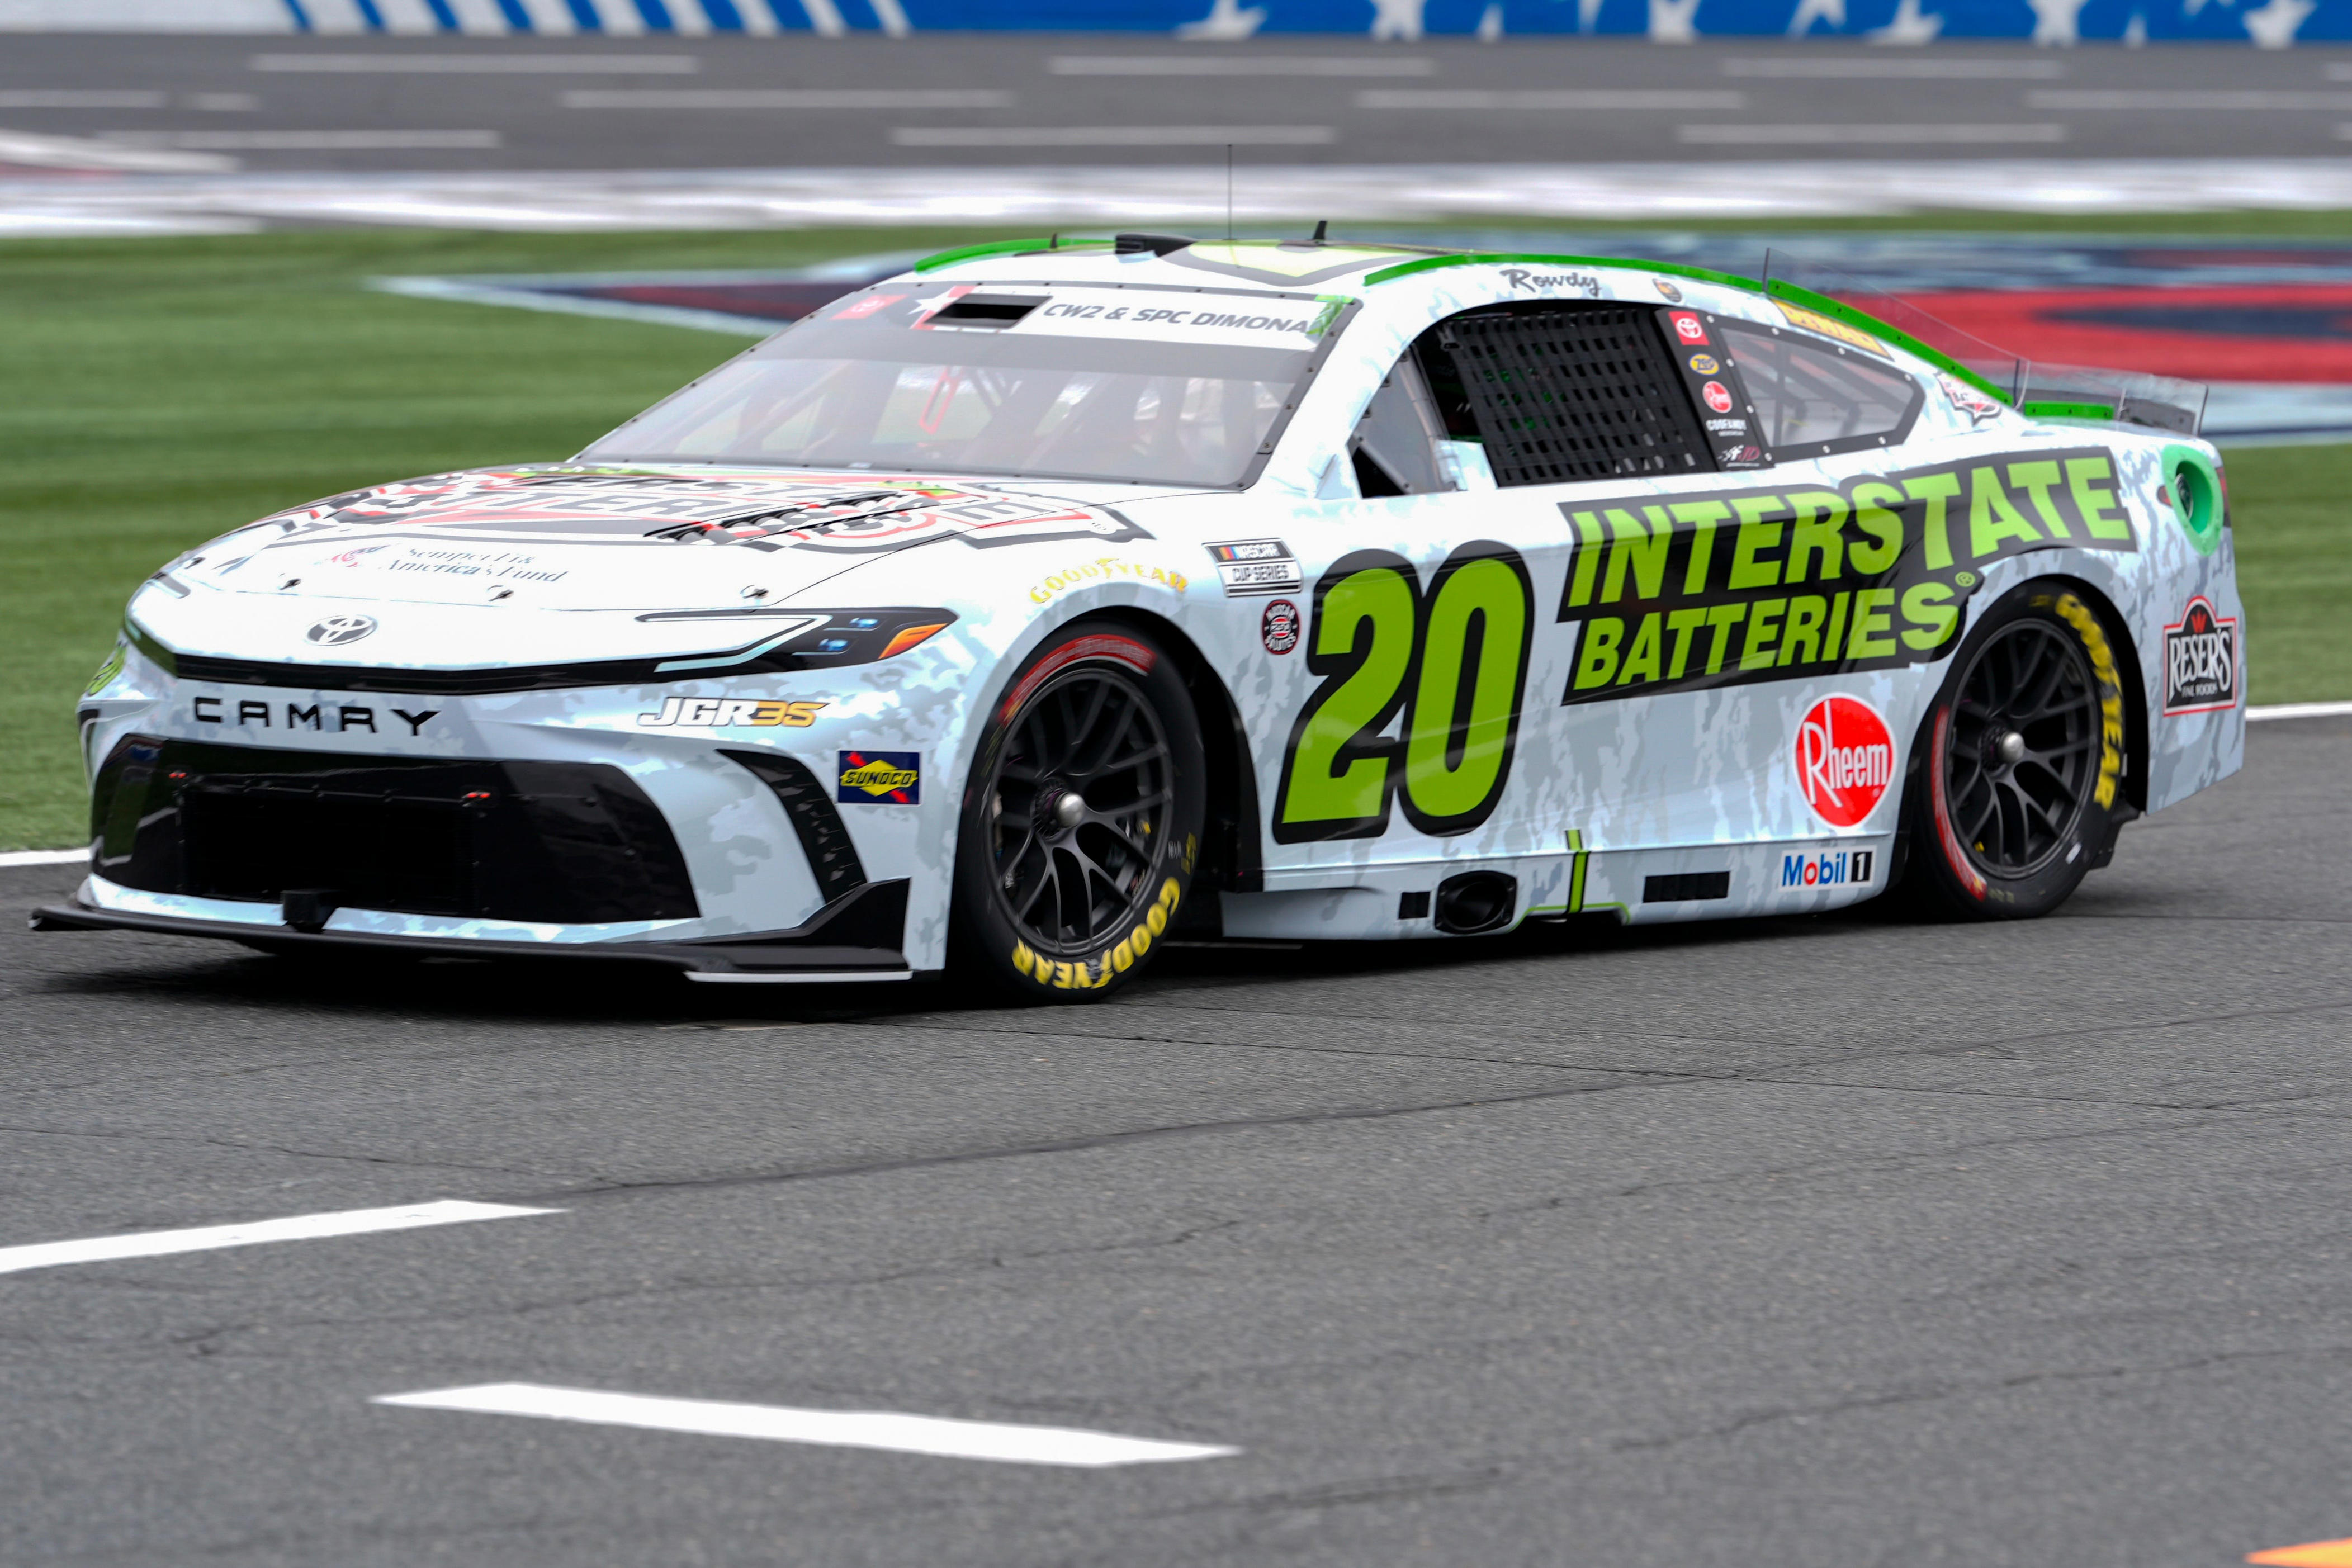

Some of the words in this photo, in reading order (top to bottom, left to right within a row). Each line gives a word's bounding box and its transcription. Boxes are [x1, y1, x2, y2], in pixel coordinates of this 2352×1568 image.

[1499, 268, 1602, 297] Rowdy
[1044, 304, 1105, 318] CW2
[1104, 307, 1130, 320] &
[1131, 309, 1191, 324] SPC
[1190, 312, 1310, 334] DIMONA
[1568, 456, 2131, 607] INTERSTATE
[1029, 557, 1189, 604] GOODYEAR
[1232, 566, 1252, 582] CUP
[1253, 564, 1290, 581] SERIES
[1573, 581, 1959, 691] BATTERIES
[2168, 628, 2232, 704] RESER'S
[1280, 556, 1527, 826] 20
[194, 697, 441, 736] CAMRY
[1801, 699, 1888, 808] Rheem
[845, 771, 912, 785] SUNOCO
[1782, 852, 1848, 887] Mobil
